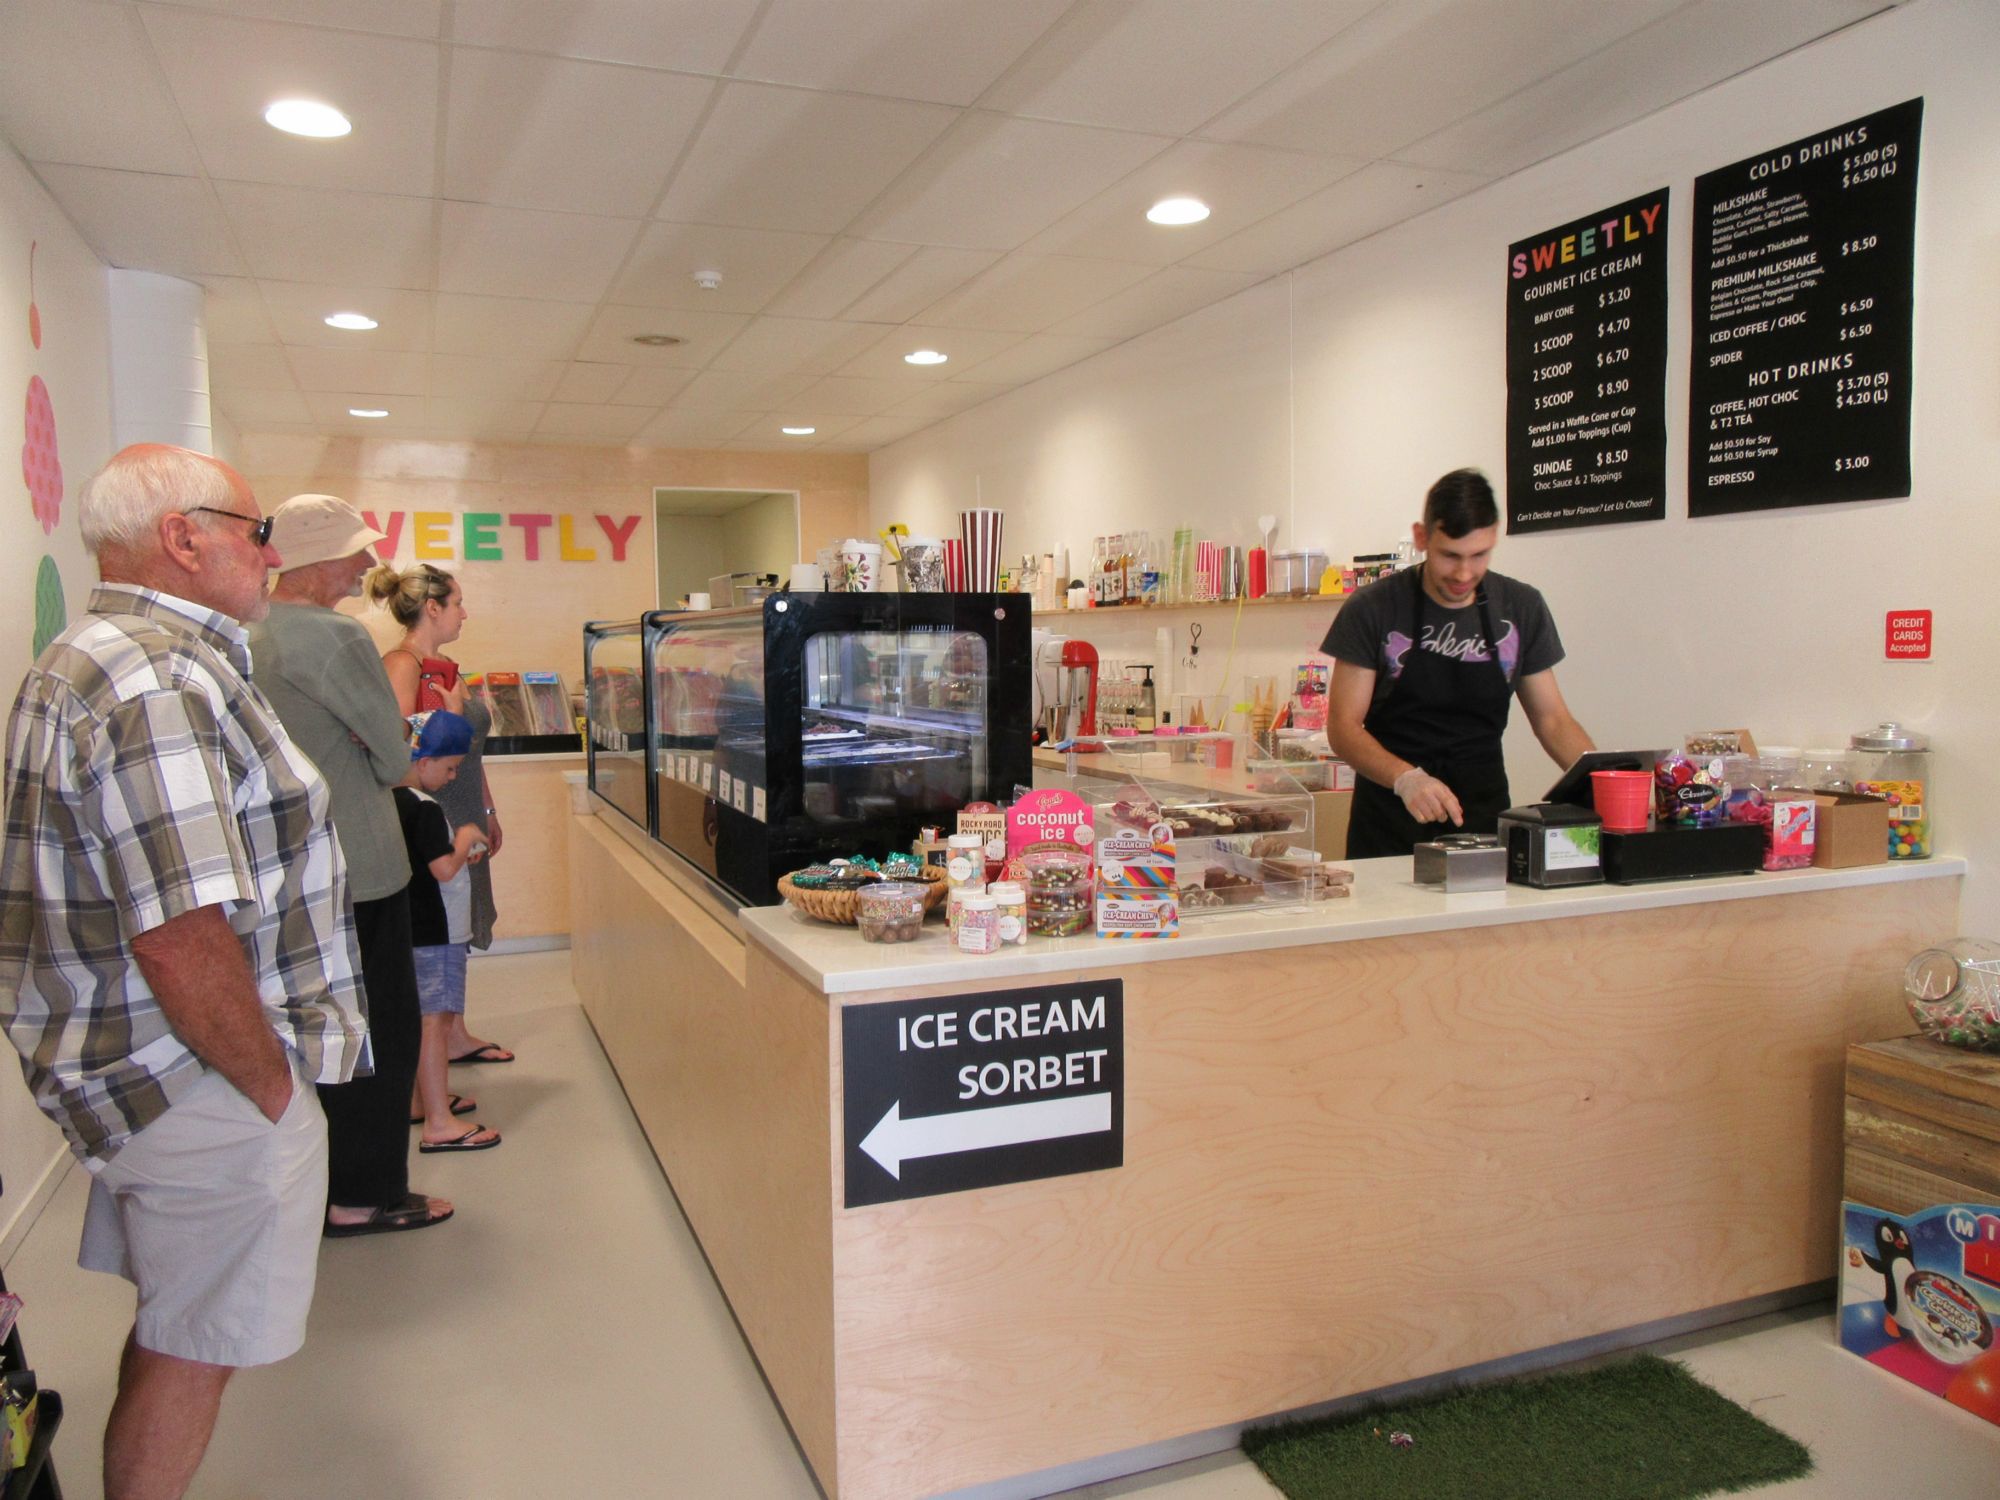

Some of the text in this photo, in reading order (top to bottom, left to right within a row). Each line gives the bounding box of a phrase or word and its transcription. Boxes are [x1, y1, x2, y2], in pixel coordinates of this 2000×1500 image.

[1750, 127, 1867, 180] COLD DRINKS
[1854, 150, 1879, 168] 5.00
[1882, 144, 1897, 160] (S)
[1852, 167, 1878, 184] 6.50
[1881, 161, 1896, 178] (L)
[1714, 188, 1767, 215] MILKSHAKE
[1513, 204, 1661, 279] SWEETLY
[1852, 236, 1877, 252] 8.50
[1712, 258, 1725, 269] Add
[1727, 252, 1747, 265] $0.50
[1748, 250, 1759, 258] for
[1768, 236, 1809, 252] Thickshake
[1524, 253, 1642, 301] GOURMET ICE CREAM
[1712, 252, 1816, 291] PREMIUM MILKSHAKE
[1609, 287, 1631, 304] 3.20
[1850, 298, 1873, 312] 6.50
[1535, 305, 1574, 325] BABY CONE
[1607, 318, 1630, 334] 4.70
[1710, 312, 1806, 343] ICED COFFEE / CHOC
[1849, 324, 1872, 338] 6.50
[1534, 333, 1573, 354] 1 SCOOP
[1606, 348, 1629, 364] 6.70
[1710, 351, 1742, 367] SPIDER
[1534, 362, 1572, 382] 2 SCOOP
[1749, 353, 1853, 387] HOT DRINKS
[1607, 379, 1629, 395] 8.90
[1848, 375, 1871, 390] 3.70
[1874, 372, 1889, 387] (S)
[1535, 391, 1574, 410] 3 SCOOP
[1710, 390, 1799, 415] COFFEE, HOT CHOC
[1846, 392, 1871, 405] 4.20
[1874, 389, 1888, 404] (L)
[1528, 407, 1636, 435] Served in a Waffle Cone or Cup
[1711, 414, 1752, 430] & T2 TEA
[1532, 422, 1631, 448] Add $1.00 for Toppings (Cup)
[1606, 450, 1628, 464] 8.50
[1846, 456, 1870, 469] 3.00
[1534, 459, 1572, 476] SUNDAE
[1535, 472, 1622, 491] Choc Sauce & 2 Toppings
[1709, 471, 1755, 486] ESPRESSO
[361, 511, 642, 561] EETLY
[1892, 618, 1925, 628] CREDIT
[1893, 631, 1923, 641] CARDS
[1890, 643, 1926, 654] Accepted
[961, 820, 1002, 829] ROCKY ROAD
[1017, 809, 1085, 825] coconut
[1040, 825, 1065, 840] ice
[899, 996, 1105, 1051] ICE CREAM
[958, 1049, 1107, 1100] SORBET
